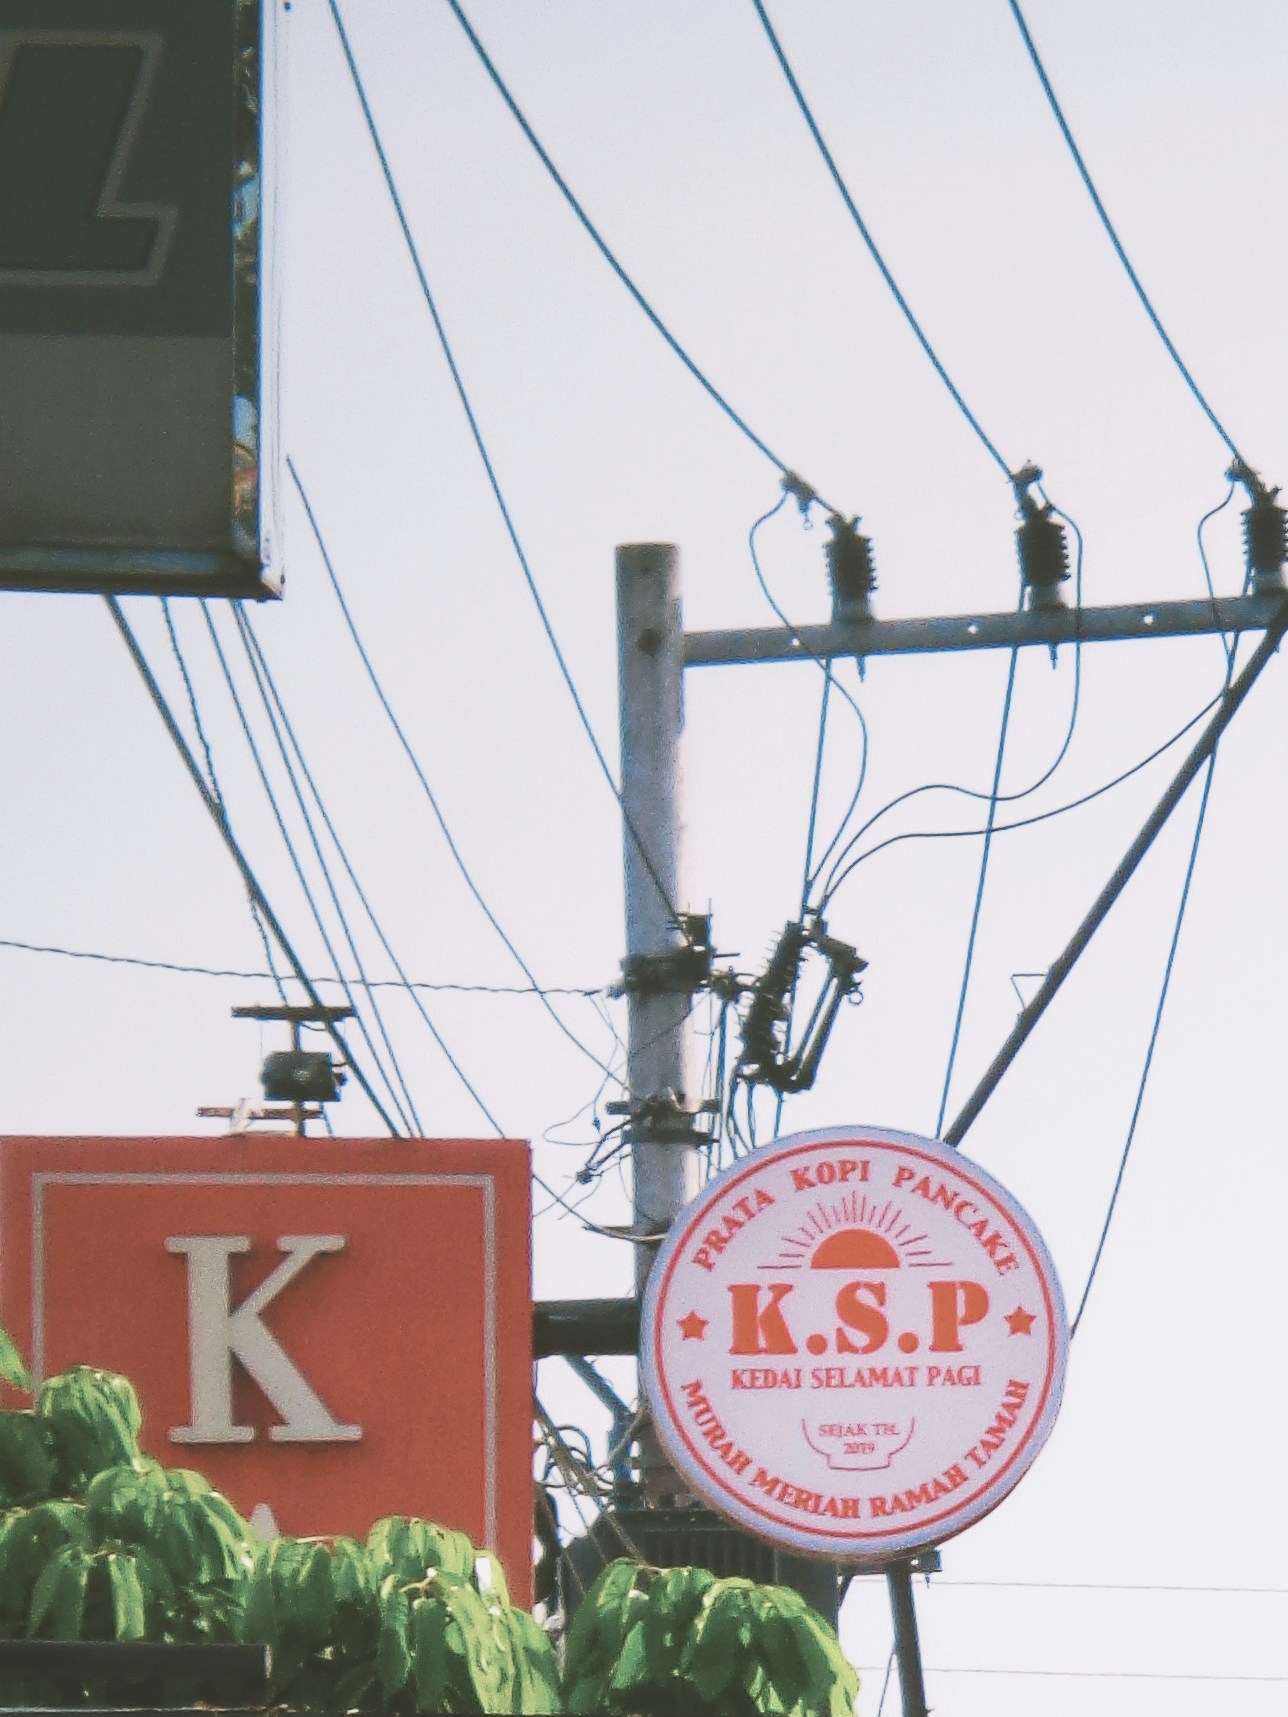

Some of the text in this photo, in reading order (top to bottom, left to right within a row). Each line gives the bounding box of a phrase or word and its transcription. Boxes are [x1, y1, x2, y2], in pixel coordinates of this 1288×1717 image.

[691, 1159, 1019, 1276] PRATA KOPI PANCAKE
[164, 1235, 363, 1443] K
[728, 1281, 990, 1356] K.S.P
[731, 1365, 982, 1390] KEDAI SELAMAT PAGI
[681, 1379, 752, 1475] MURAH
[749, 1467, 860, 1518] MERIAH
[868, 1464, 968, 1518] RAMAH
